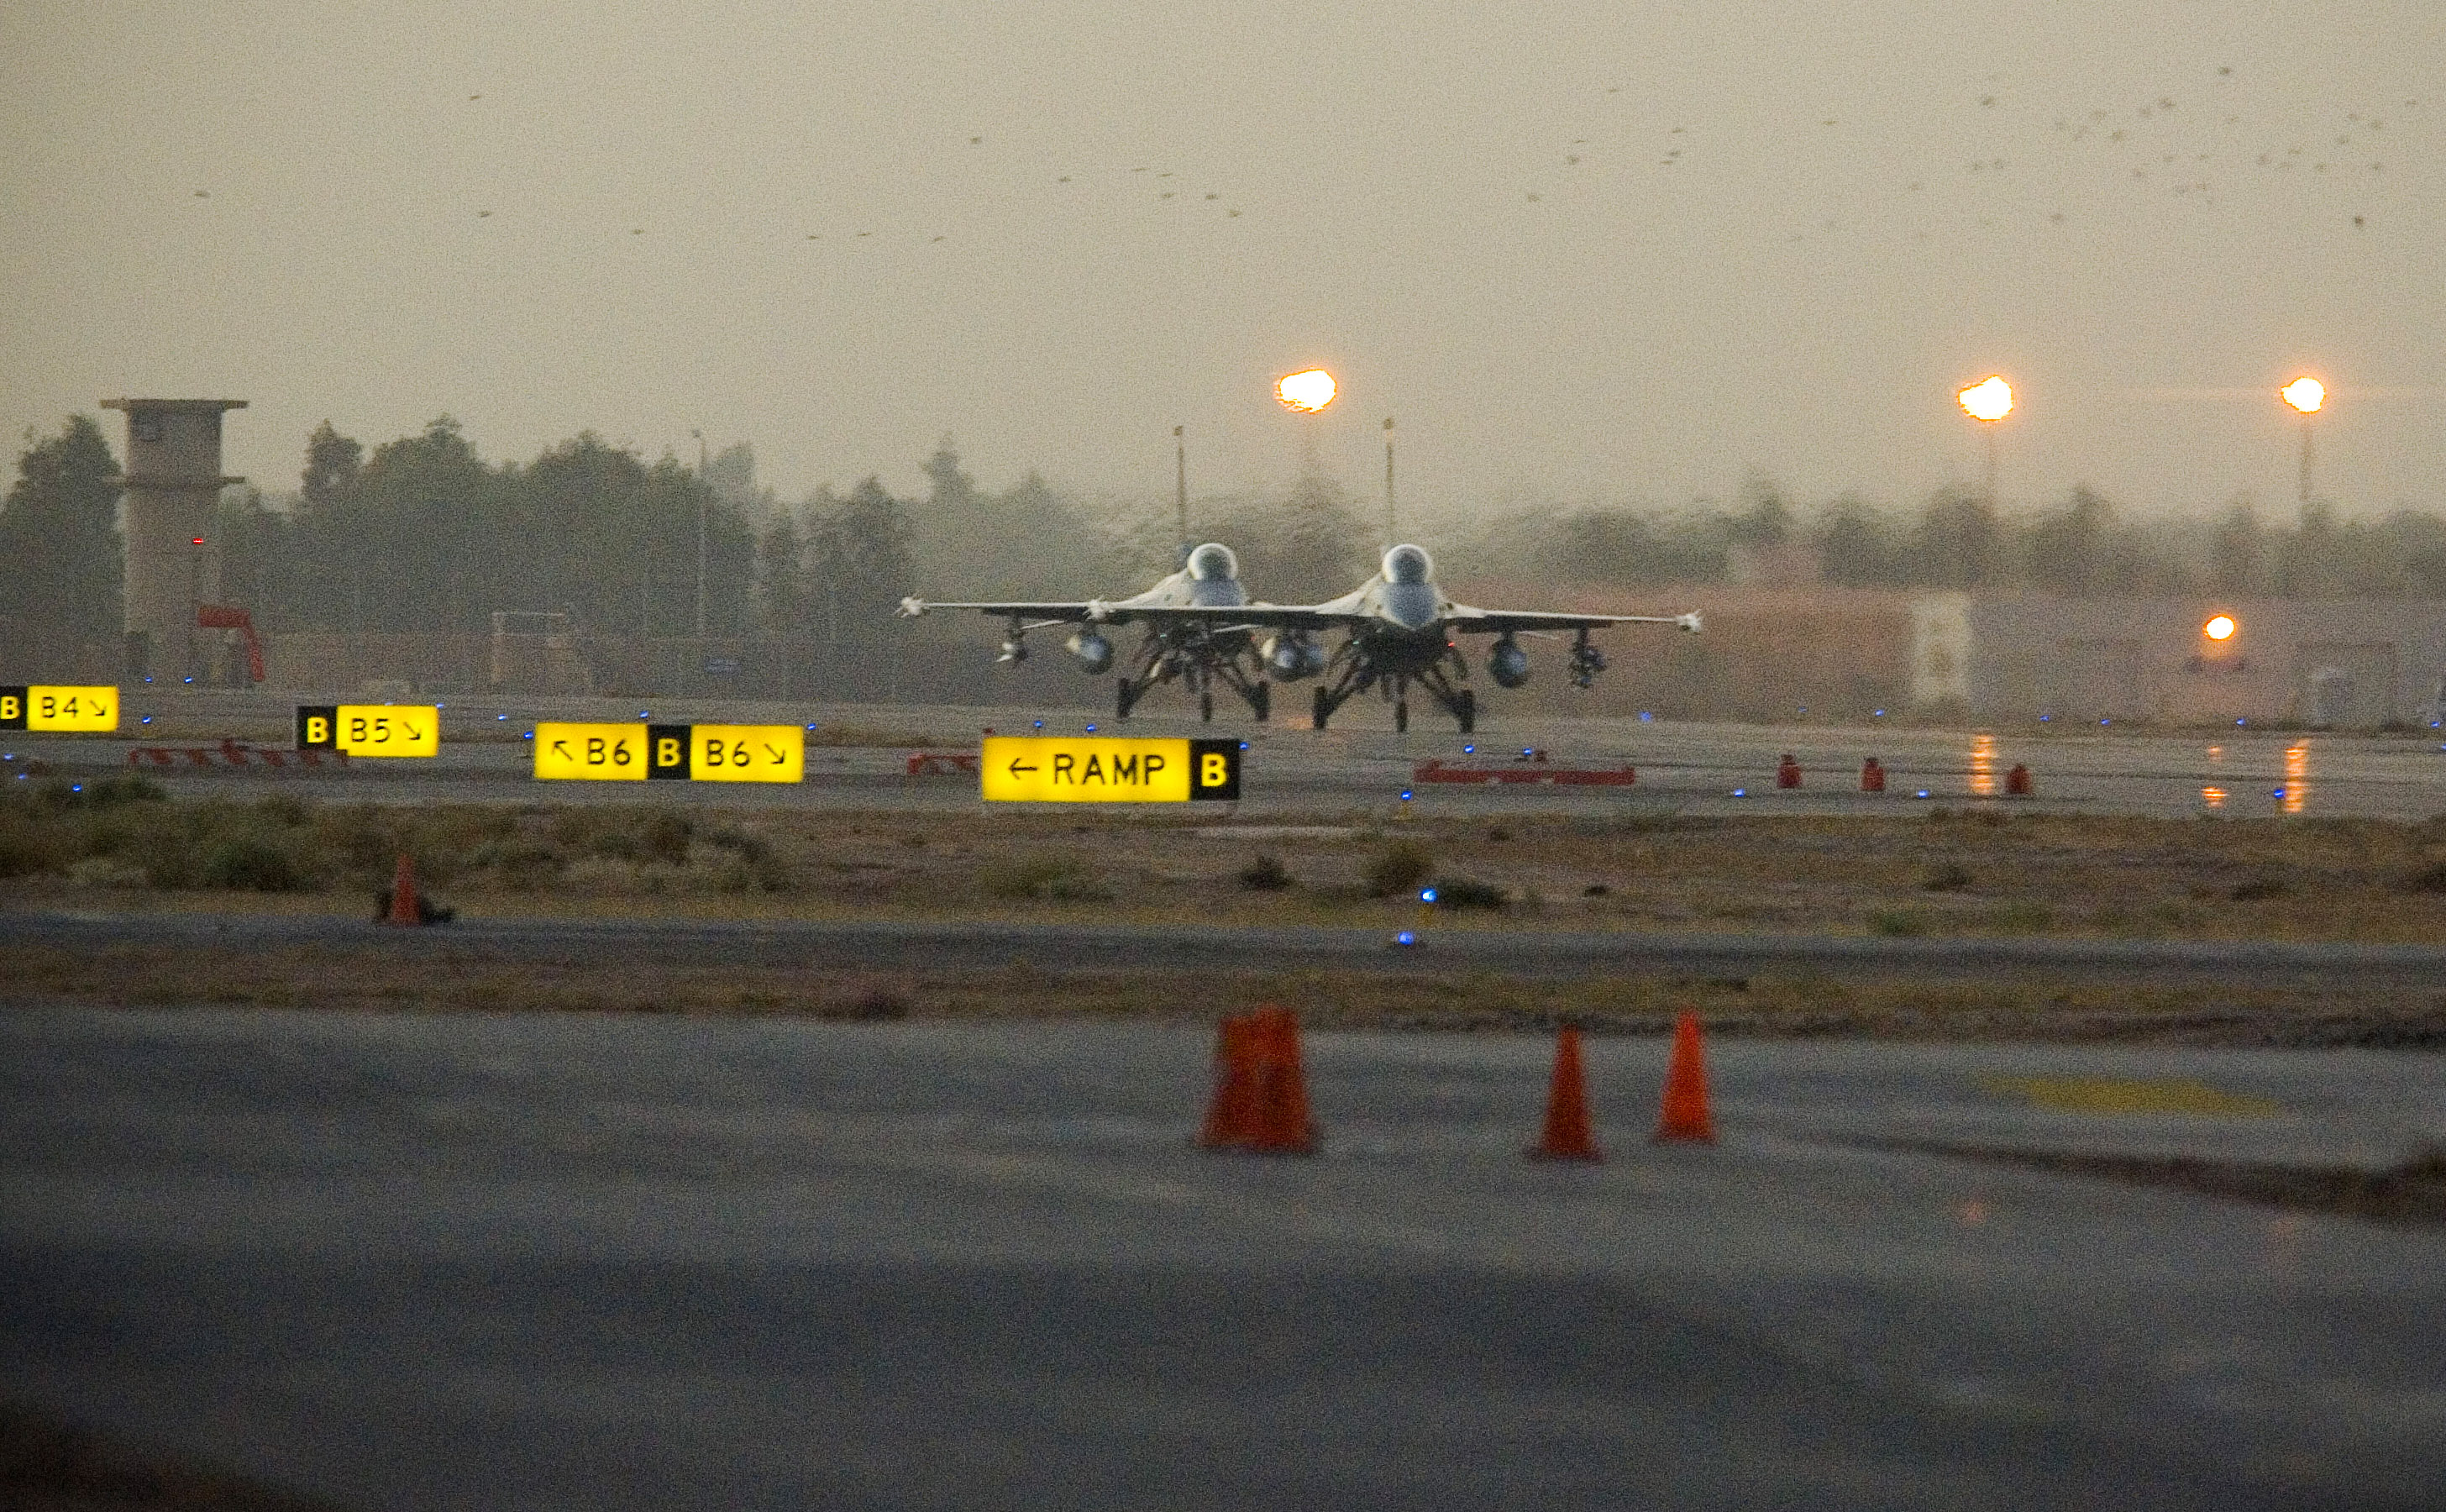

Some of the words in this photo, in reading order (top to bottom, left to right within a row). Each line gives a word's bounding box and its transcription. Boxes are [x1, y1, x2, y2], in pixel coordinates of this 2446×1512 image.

[0, 696, 20, 720] B
[41, 696, 79, 718] B4
[307, 717, 329, 743] B
[351, 718, 391, 743] B5
[587, 738, 632, 766] B6
[657, 738, 681, 768] B
[706, 739, 750, 767] B6
[1053, 753, 1166, 785] RAMP
[1200, 753, 1227, 787] B
